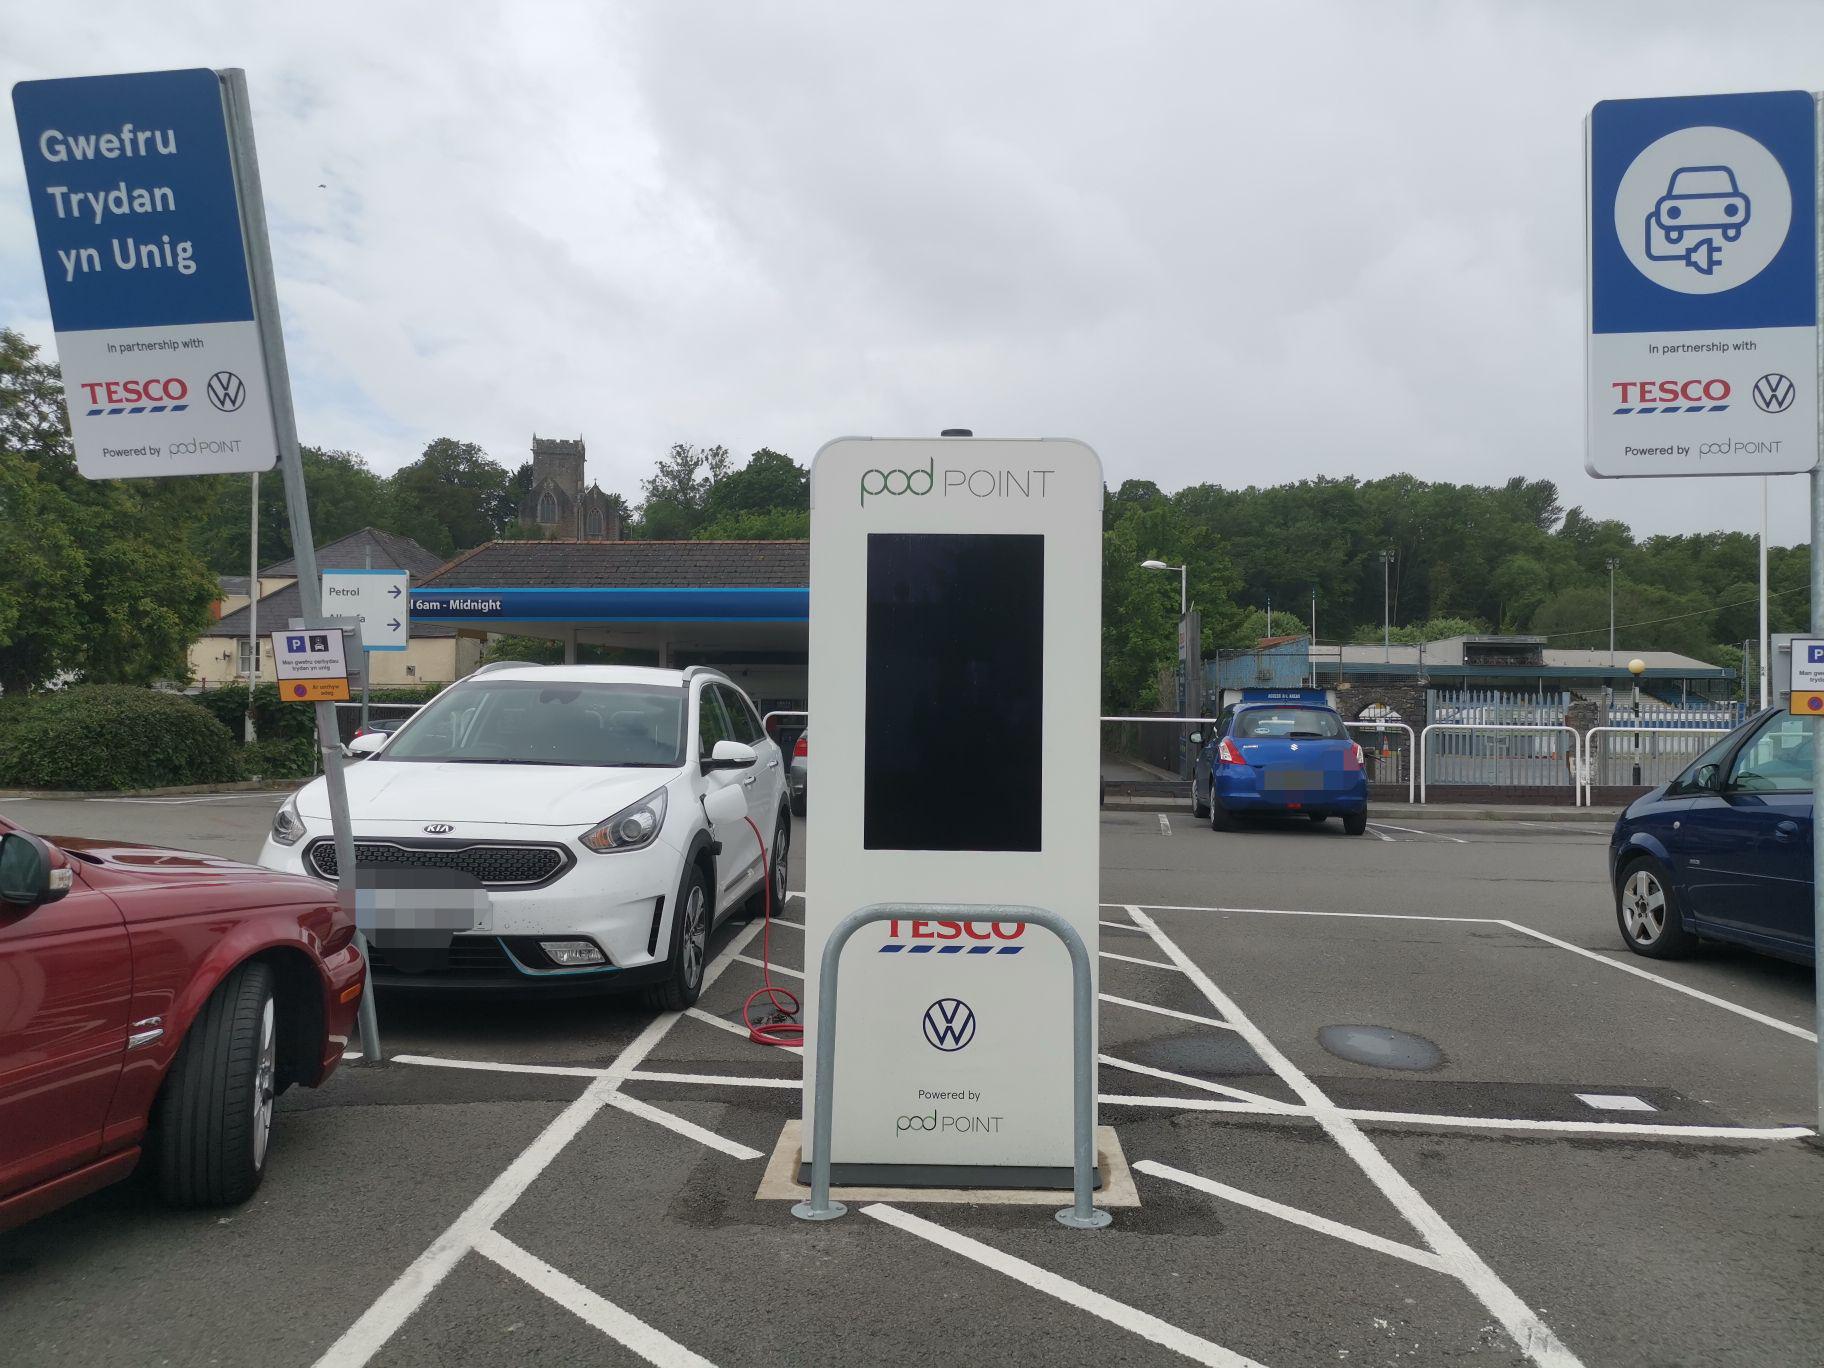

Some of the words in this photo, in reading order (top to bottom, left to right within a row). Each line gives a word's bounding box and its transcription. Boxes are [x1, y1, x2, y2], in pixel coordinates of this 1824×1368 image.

[39, 123, 177, 163] Gwefru
[46, 181, 176, 225] Trydan
[57, 246, 102, 282] yn
[112, 234, 197, 275] Unig
[107, 342, 117, 353] In
[119, 339, 180, 355] partnership
[181, 337, 204, 349] with
[1649, 344, 1659, 354] In
[1662, 341, 1730, 356] partnership
[1733, 340, 1757, 351] with
[81, 377, 188, 405] TESCO
[1612, 378, 1731, 404] TESCO
[102, 445, 145, 458] Powered
[148, 445, 161, 457] by
[168, 437, 196, 459] pod
[200, 440, 241, 454] POINT
[1625, 445, 1674, 456] Powered
[1677, 445, 1690, 457] by
[1699, 438, 1731, 460] pod
[1734, 441, 1782, 454] POINT
[861, 456, 934, 509] pod
[944, 470, 1055, 498] POINT
[329, 587, 360, 596] Petrol
[416, 600, 440, 610] 6am
[449, 600, 501, 612] Midnight
[292, 640, 301, 650] P
[1814, 649, 1824, 660] P
[426, 824, 449, 832] KIA
[918, 1089, 965, 1100] Powered
[968, 1090, 981, 1102] by
[896, 1109, 937, 1138] pod
[942, 1116, 1003, 1133] POINT
